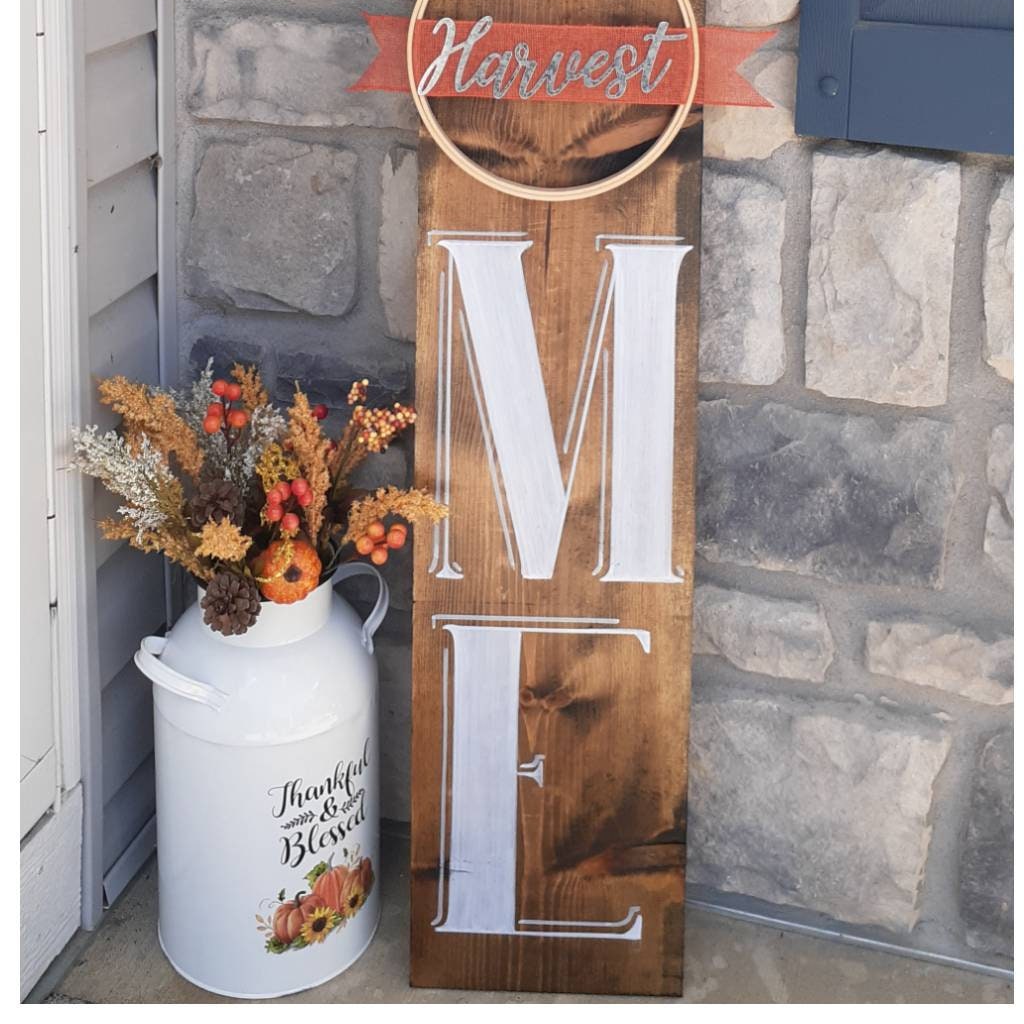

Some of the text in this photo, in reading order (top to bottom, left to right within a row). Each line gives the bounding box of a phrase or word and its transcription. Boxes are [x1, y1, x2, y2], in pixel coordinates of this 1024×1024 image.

[417, 15, 689, 100] Harvest
[267, 737, 370, 819] Thankful
[318, 796, 340, 823] &
[278, 788, 367, 869] Blessed
